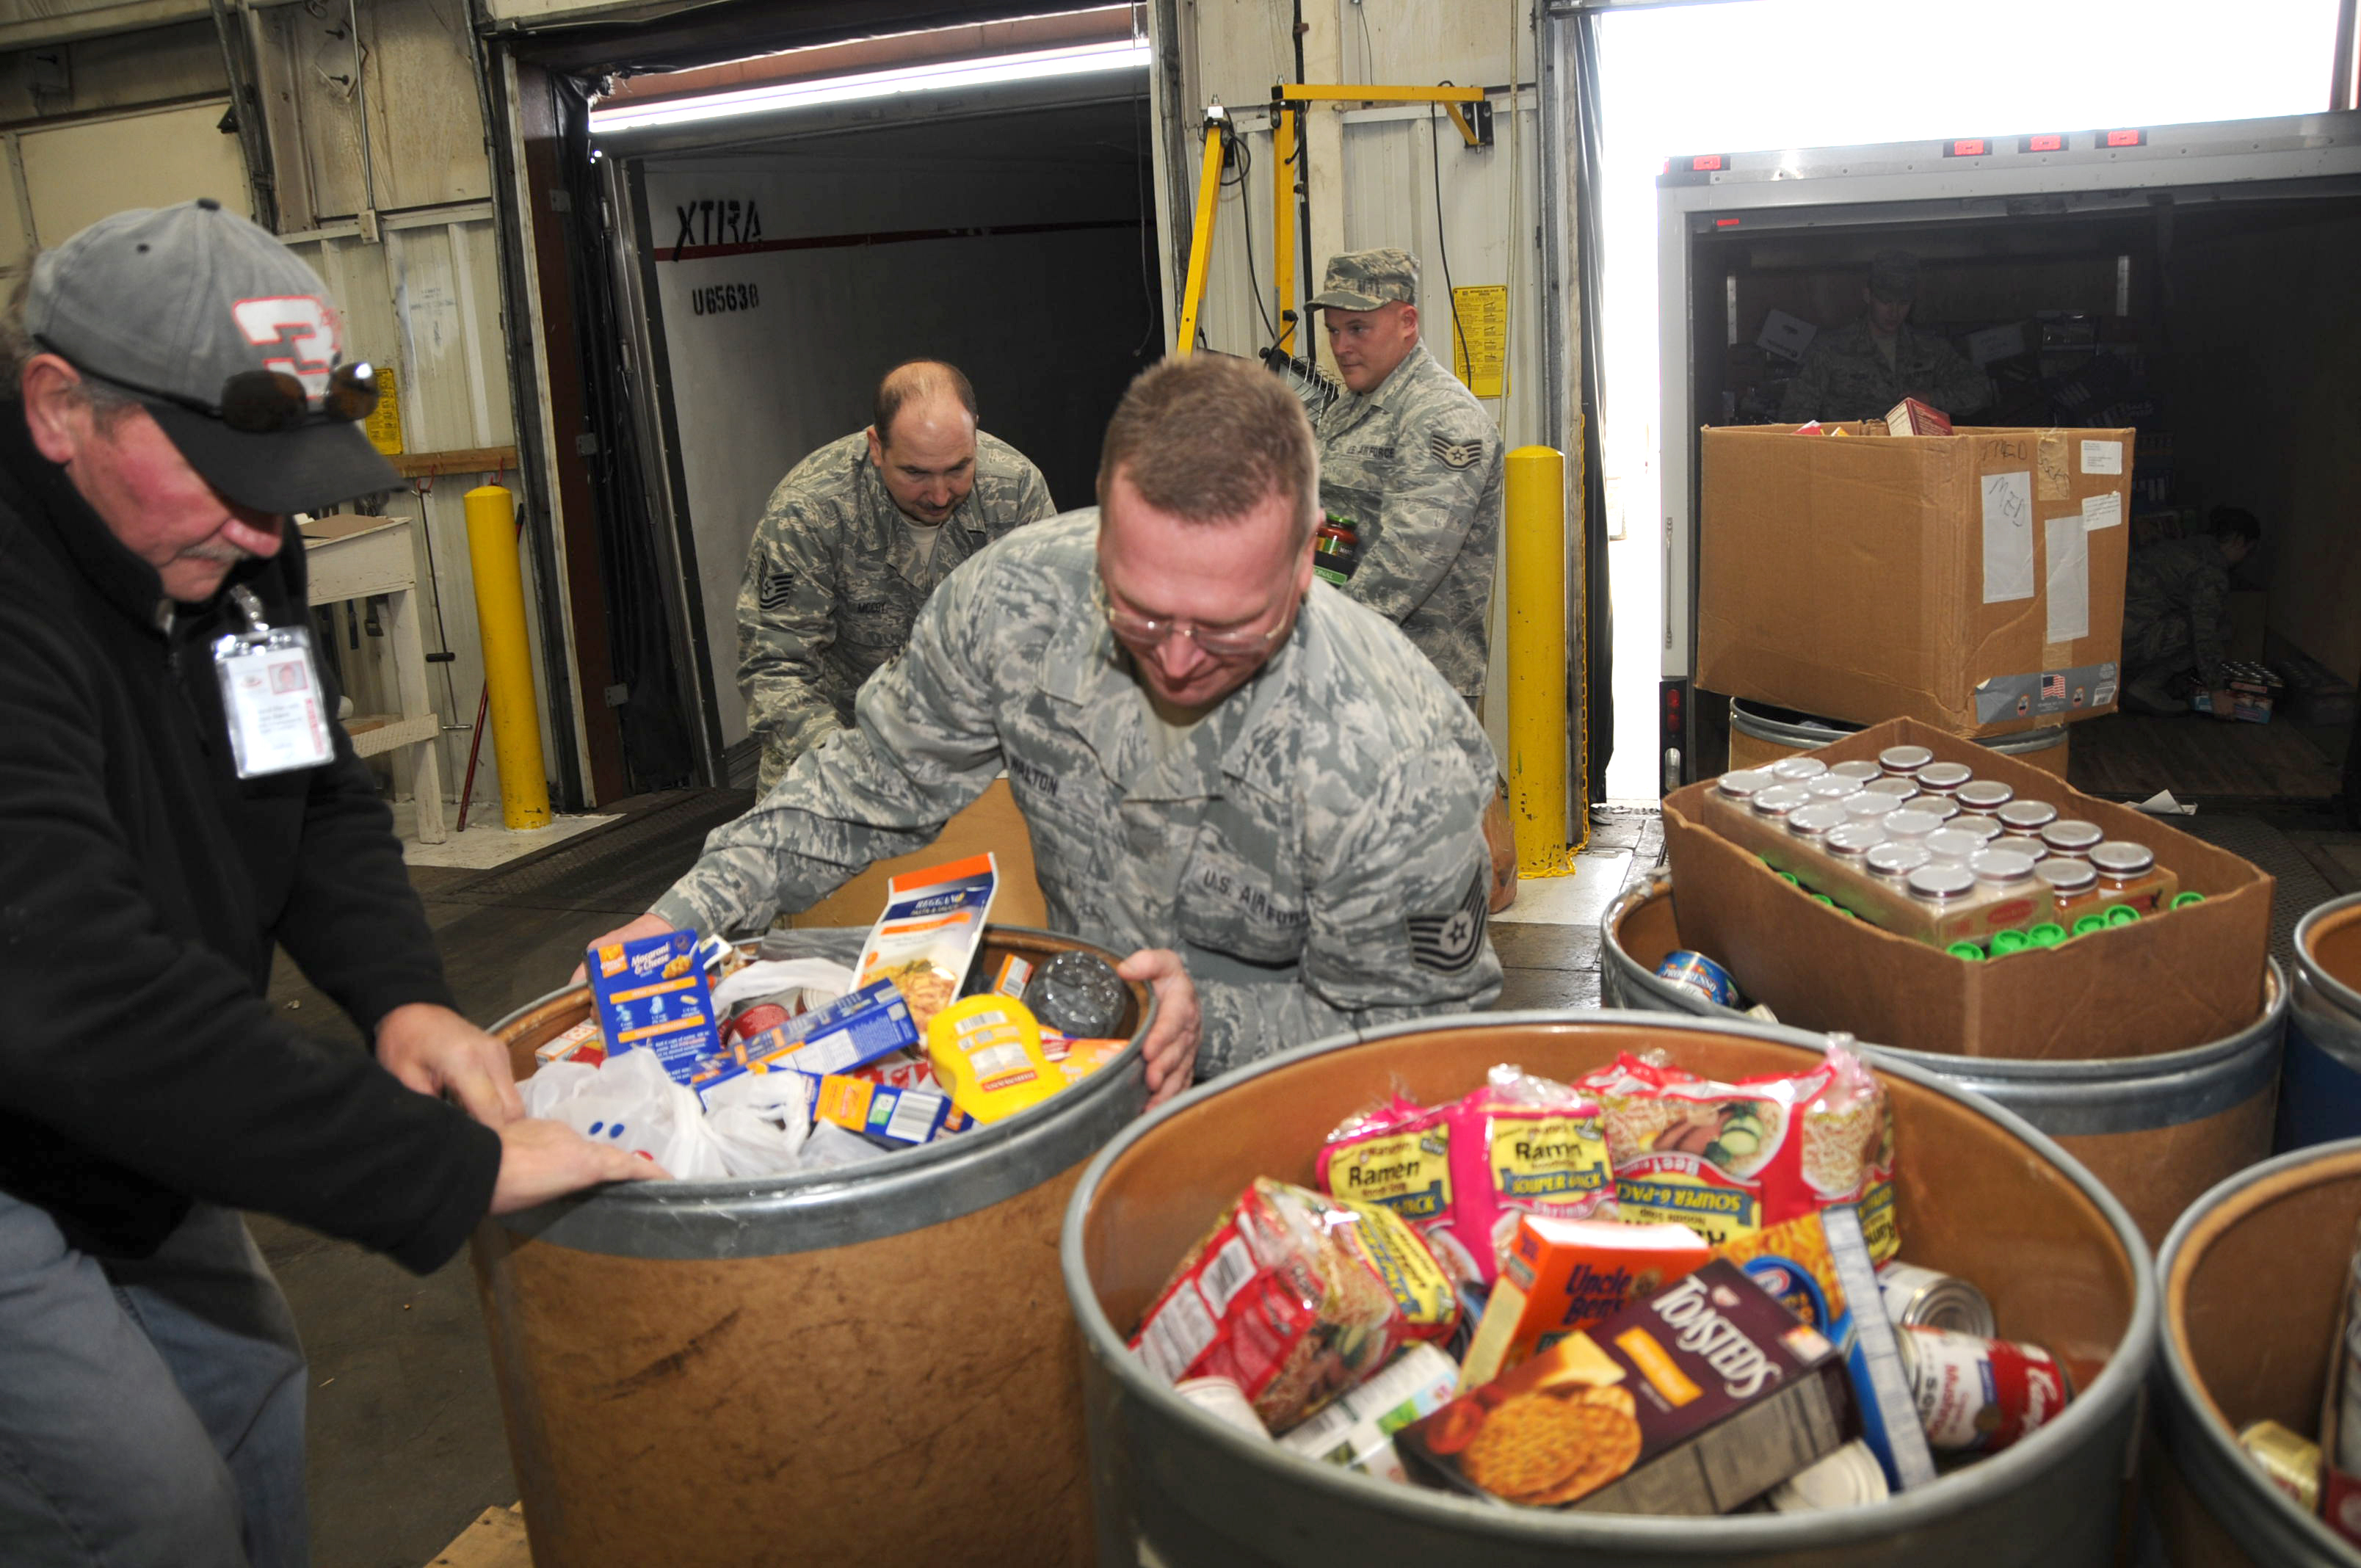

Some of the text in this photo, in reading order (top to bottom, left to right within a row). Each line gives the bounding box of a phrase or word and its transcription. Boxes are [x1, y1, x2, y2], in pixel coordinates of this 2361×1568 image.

[672, 200, 763, 262] XTRA
[232, 295, 341, 402] 3
[1203, 869, 1232, 897] U.S.
[1239, 885, 1266, 913] AIR
[631, 942, 670, 967] Macaroni
[643, 954, 670, 970] Cheese
[1663, 967, 1717, 992] PROGRESSO
[1349, 1161, 1421, 1187] Ramen
[1673, 1188, 1741, 1211] SOUPER
[1565, 1263, 1633, 1295] Uncle
[1650, 1274, 1782, 1398] TOASTEDS
